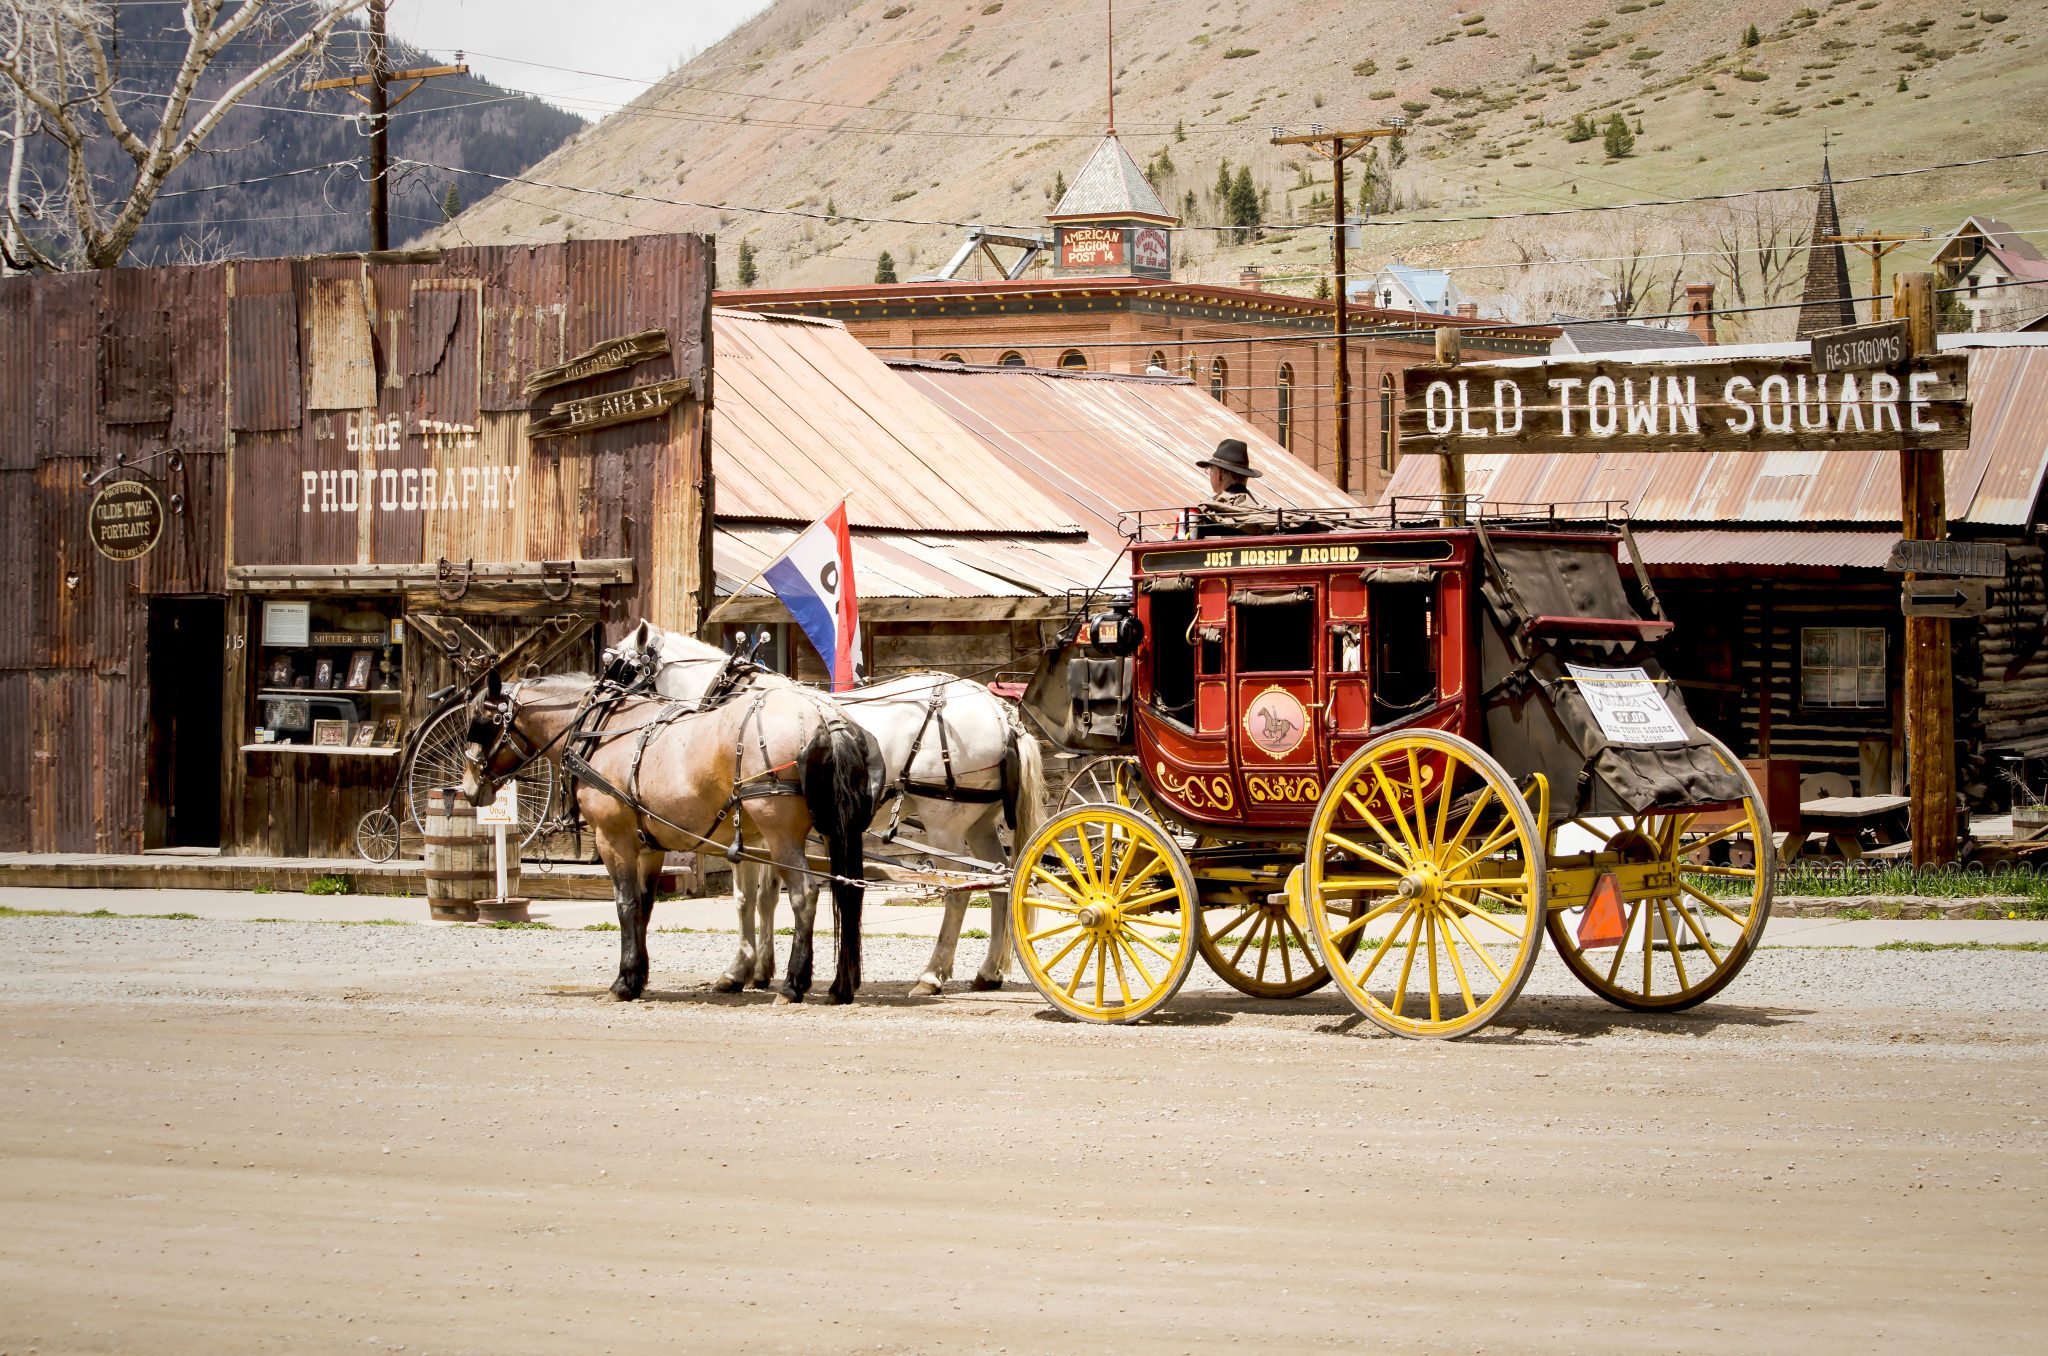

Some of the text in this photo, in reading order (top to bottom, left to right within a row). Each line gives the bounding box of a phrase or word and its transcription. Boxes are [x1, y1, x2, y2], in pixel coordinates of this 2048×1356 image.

[1064, 230, 1119, 246] AMERICAN
[1072, 241, 1109, 252] LEGION
[1069, 251, 1114, 263] POST 14
[565, 341, 638, 378] NOTORIOUS
[1826, 336, 1900, 370] RESTROOMS
[569, 392, 636, 425] BLAIR
[1425, 372, 1940, 436] OLD TOWN SQUARE
[419, 419, 475, 450] TYME
[104, 485, 142, 500] PROFESSOR
[302, 465, 520, 513] PHOTOGRAPHY
[96, 500, 153, 520] OLDE TYME
[101, 521, 151, 540] PORTRAITS
[1204, 547, 1360, 567] JUST HORSIN' AROUND
[1895, 540, 2001, 576] SILVERSMITH
[314, 635, 379, 644] SHUTTER BUG
[1616, 712, 1646, 723] $7.00
